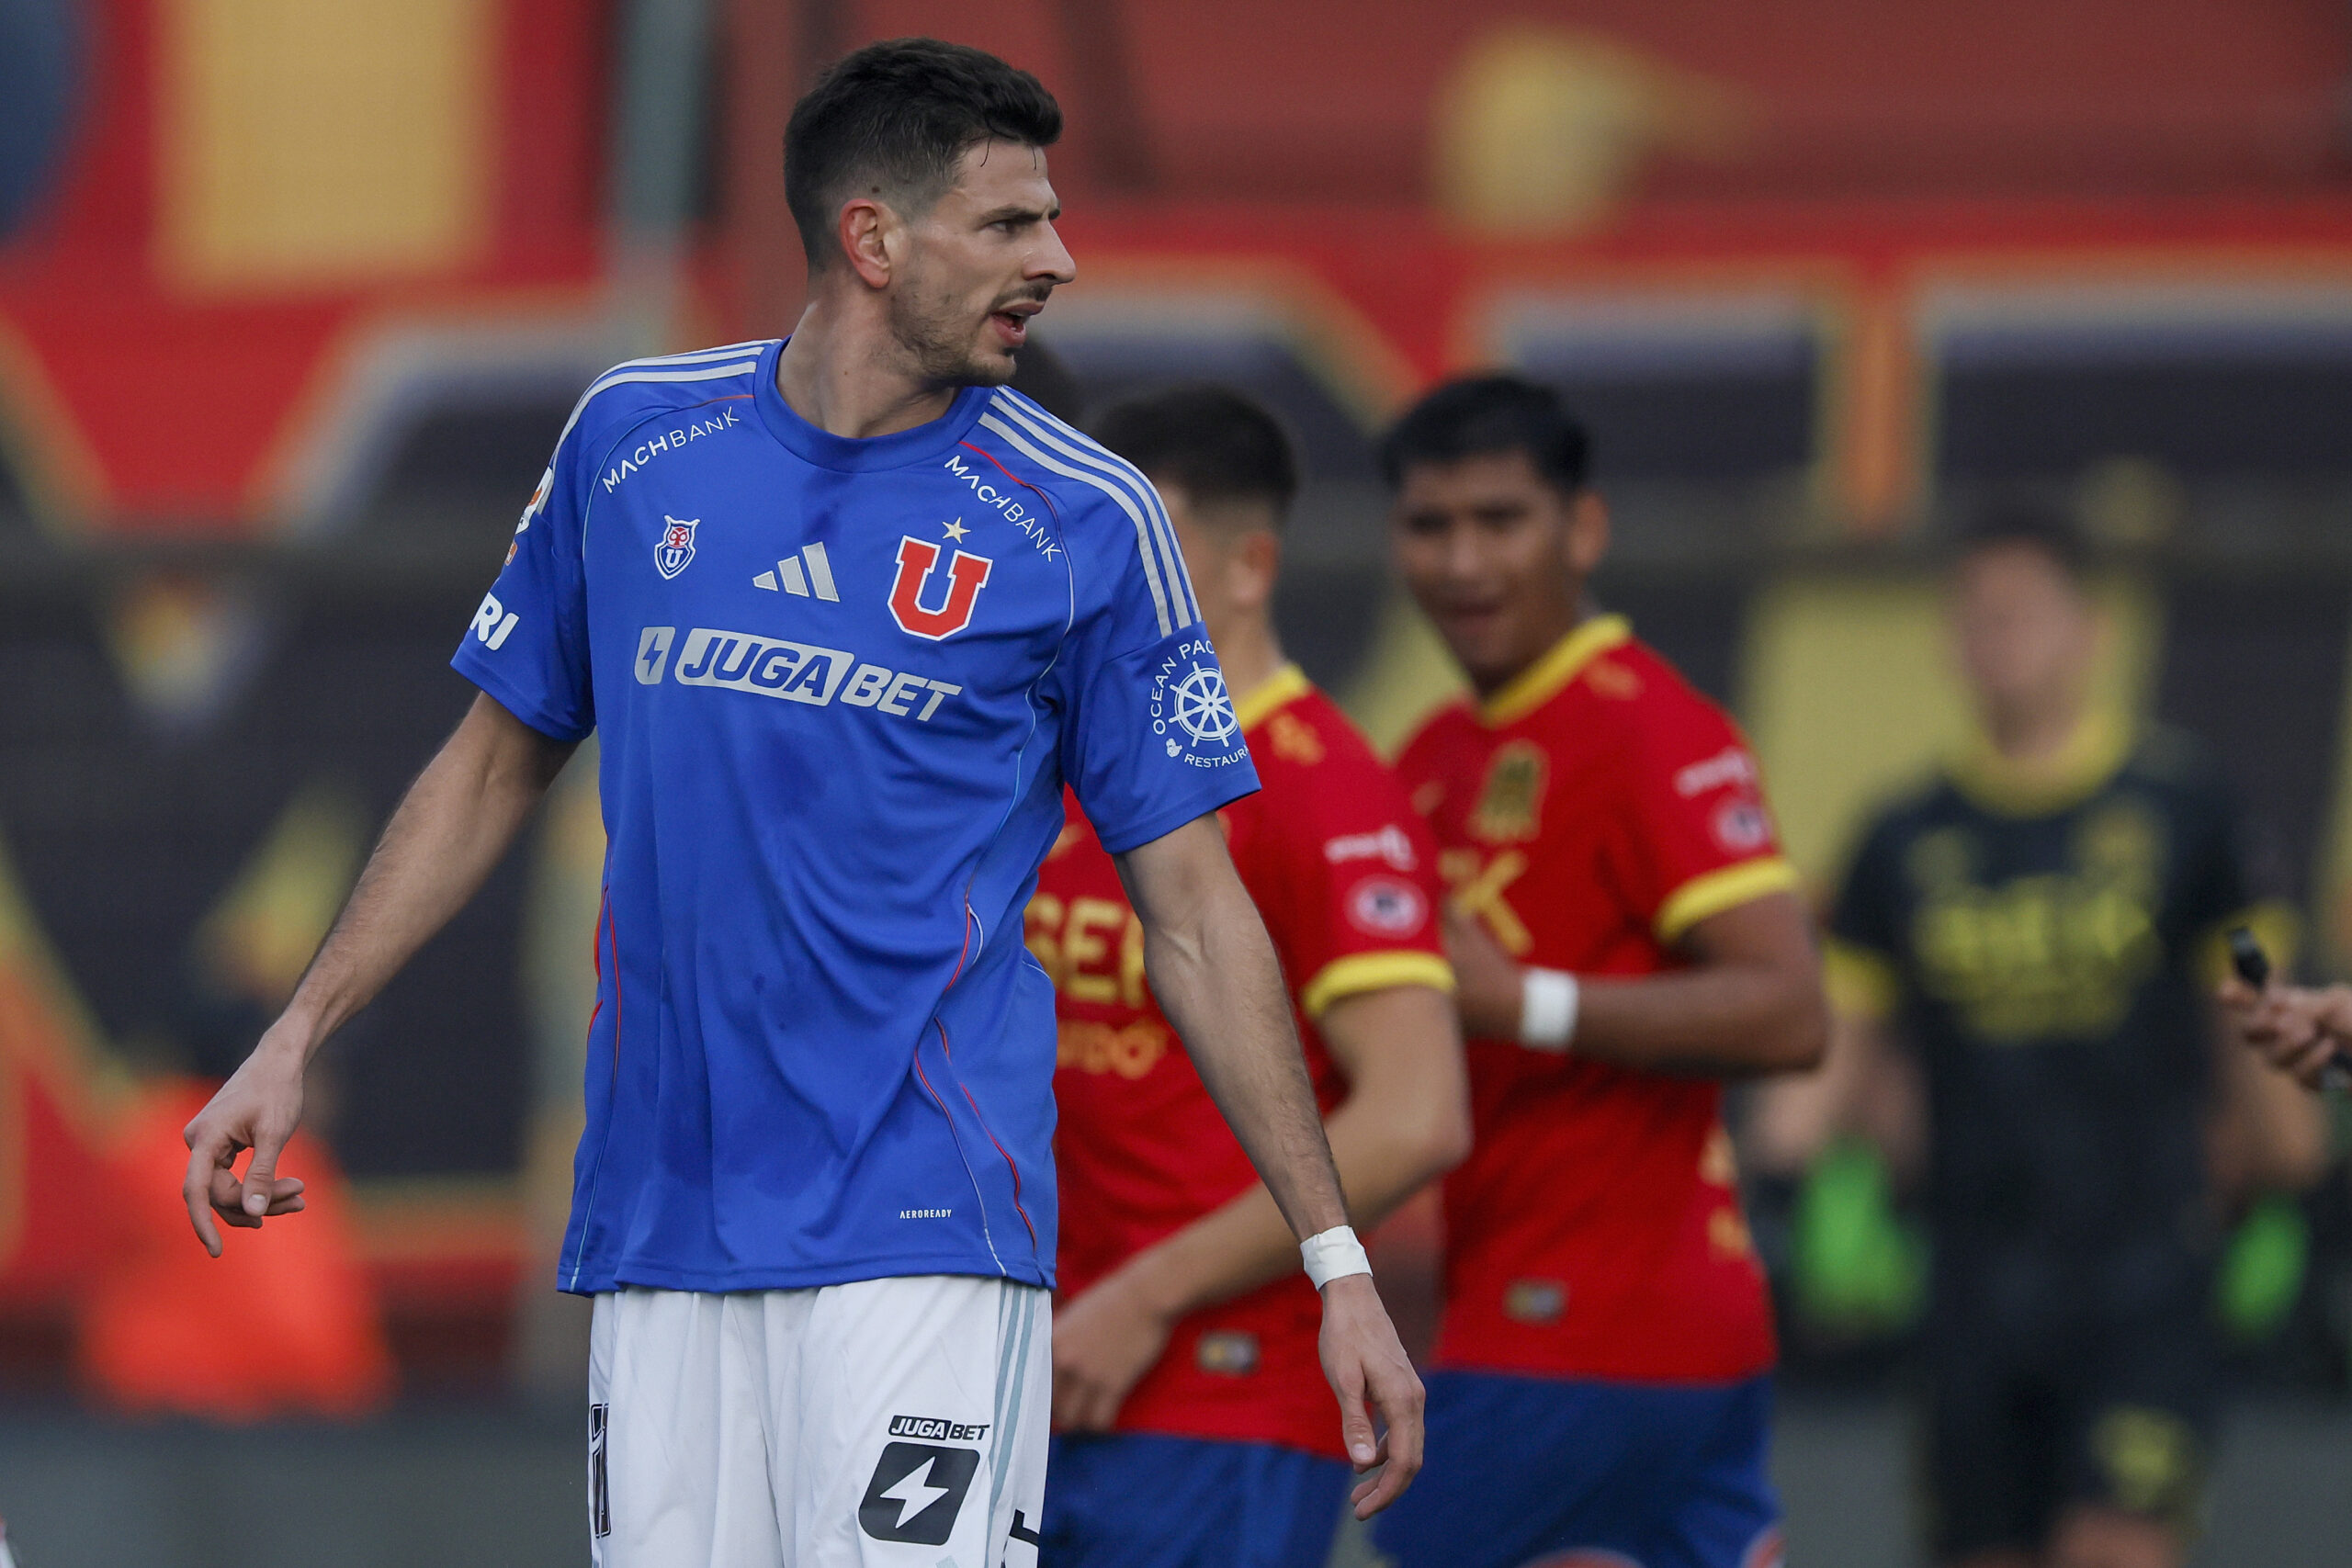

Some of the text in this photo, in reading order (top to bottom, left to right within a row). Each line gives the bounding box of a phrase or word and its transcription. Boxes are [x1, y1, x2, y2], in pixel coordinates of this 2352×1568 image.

[602, 405, 740, 494] MACHBANK
[944, 455, 1062, 562] MACHBANK
[665, 548, 684, 569] U
[888, 535, 993, 641] U
[1150, 656, 1177, 735] OCEAN
[899, 1209, 952, 1219] AEROREADY
